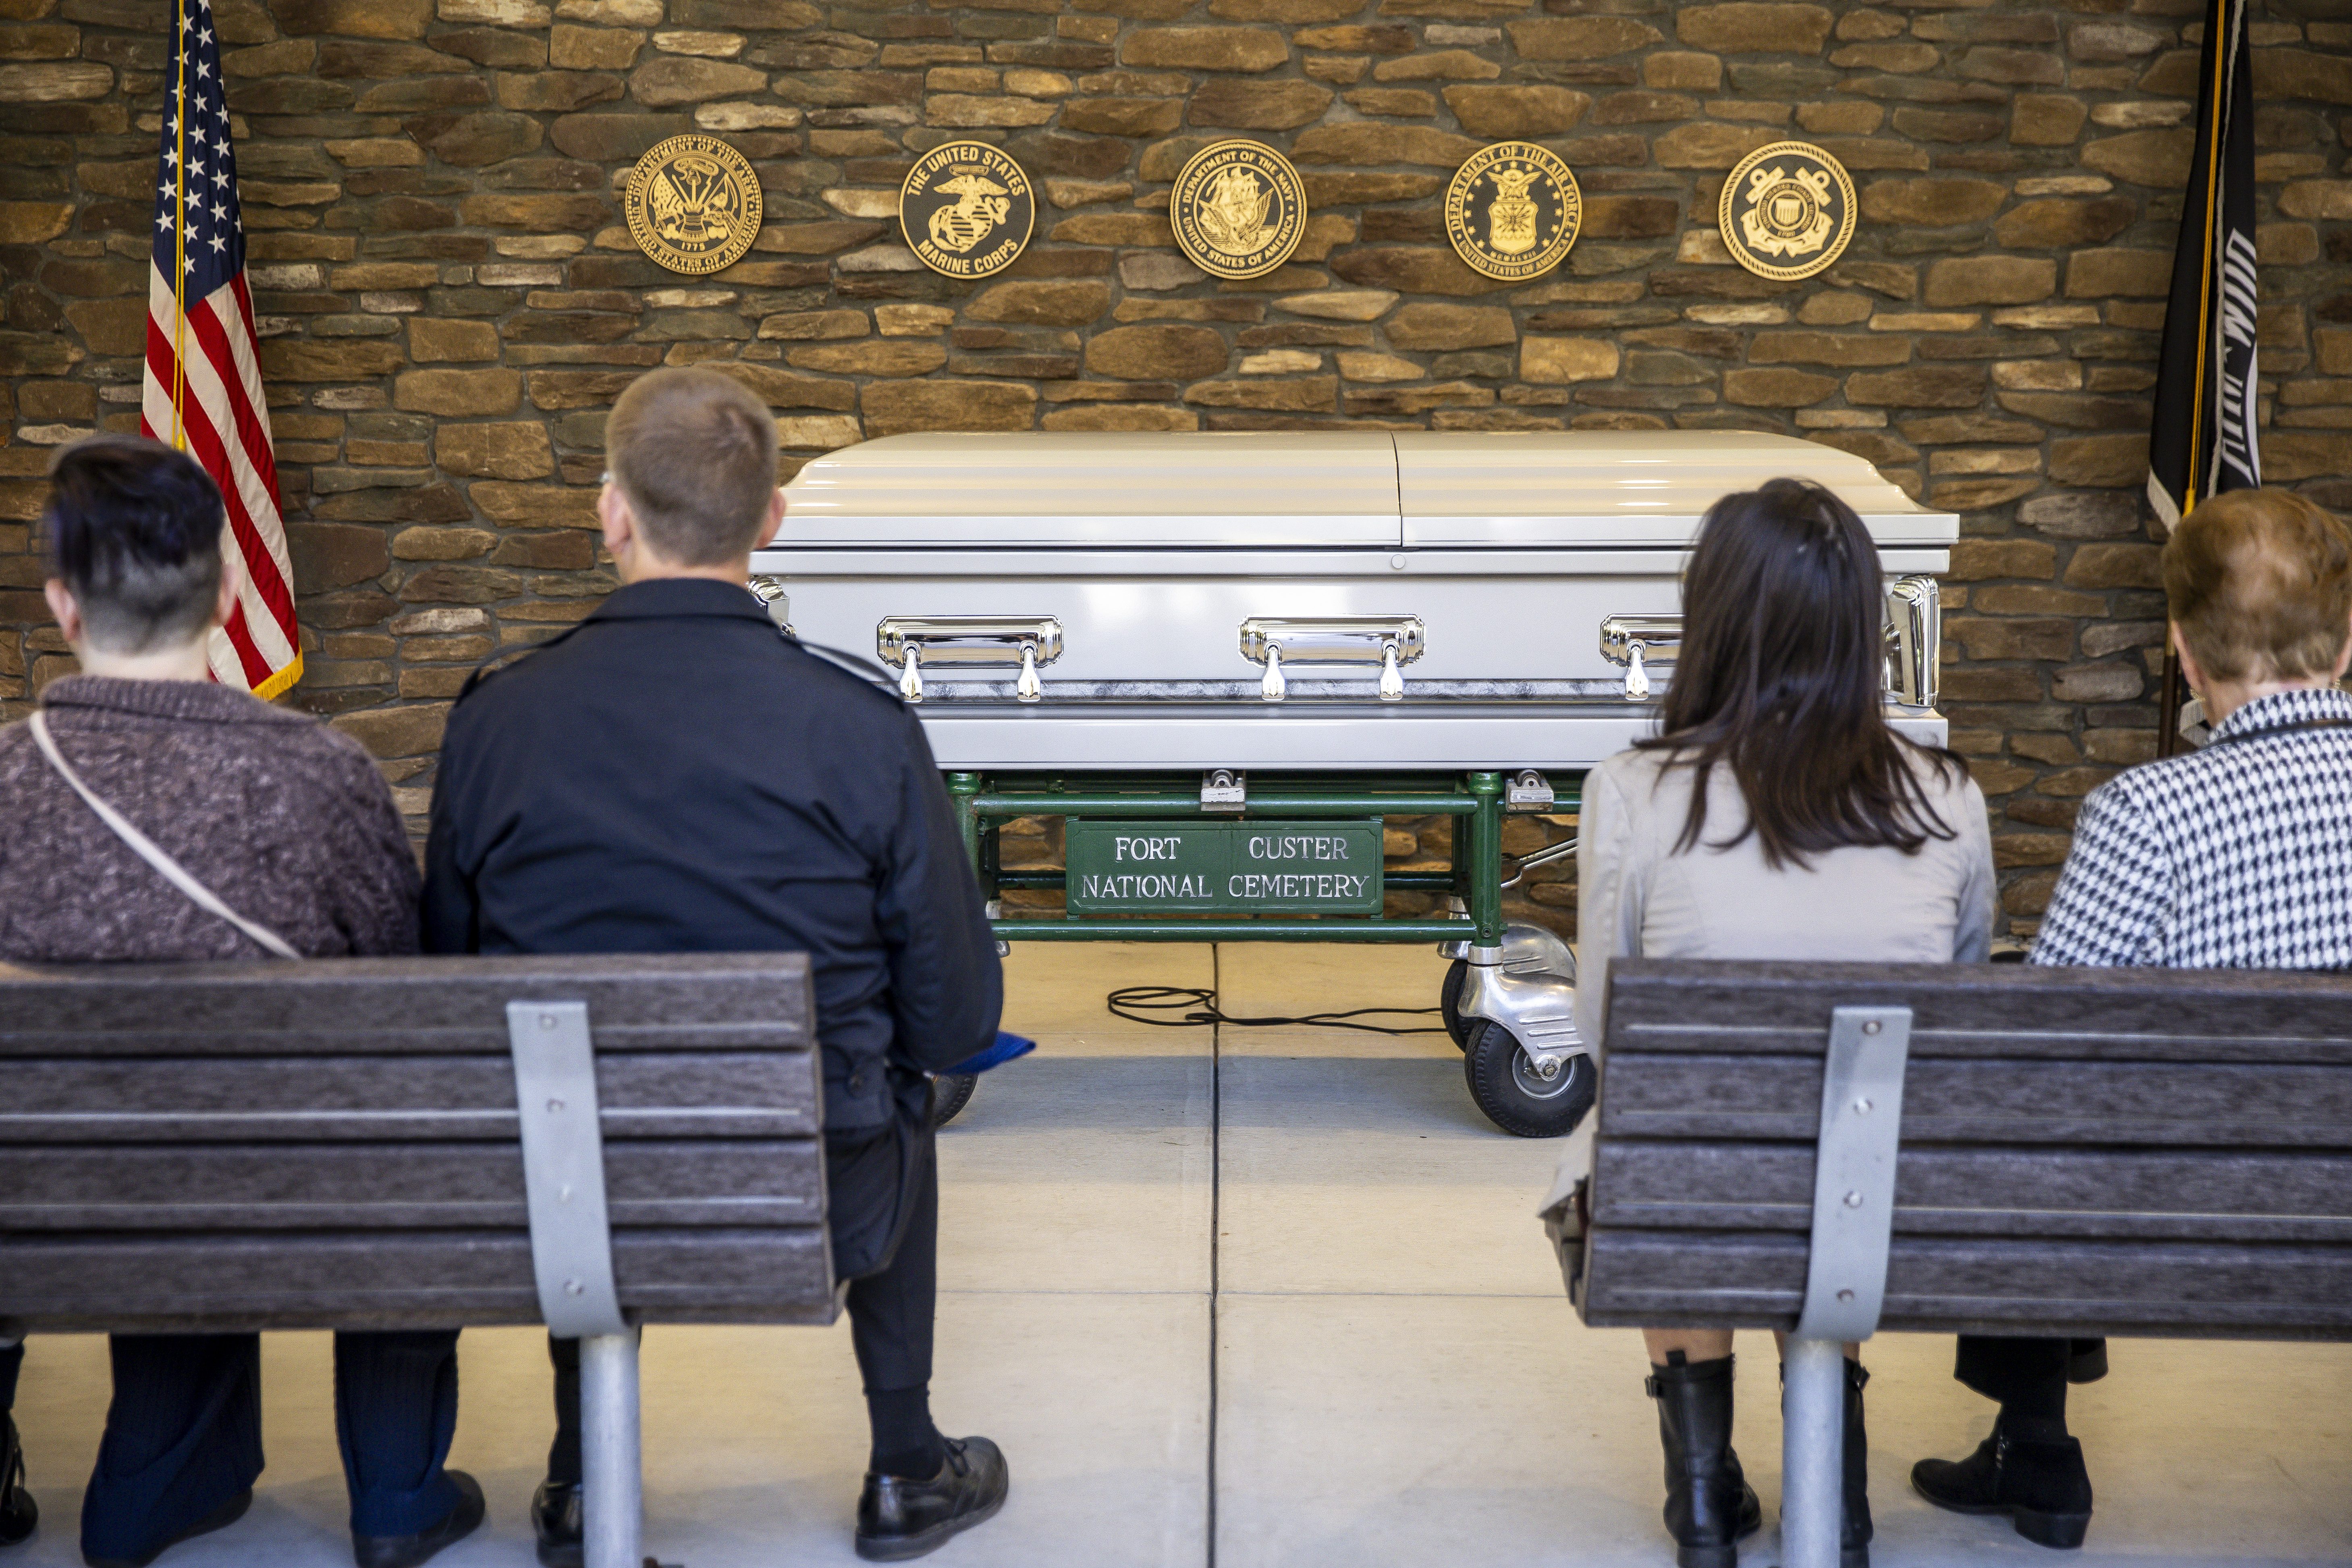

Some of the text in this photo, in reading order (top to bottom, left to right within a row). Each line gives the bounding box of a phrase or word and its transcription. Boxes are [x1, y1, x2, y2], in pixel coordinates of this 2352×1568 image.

[633, 141, 693, 197] DEPARTMENT
[717, 147, 739, 166] THE
[736, 169, 756, 202] ARMY
[907, 146, 1025, 196] THE UNITED STATES
[1182, 151, 1295, 204] DEPARTMENT OF THE NAVY
[1449, 145, 1578, 231] DEPARTMENT OF THE AIR FORCE
[631, 205, 656, 249] UNITED
[656, 247, 702, 267] STATES
[724, 211, 756, 259] AMERICA
[918, 238, 1018, 274] MARINE CORPS
[1183, 214, 1295, 268] UNITED STATES OF AMERICA
[1458, 240, 1488, 268] UNITED
[1115, 837, 1349, 861] FORT CUSTER
[1082, 874, 1370, 899] NATIONAL CEMETERY
